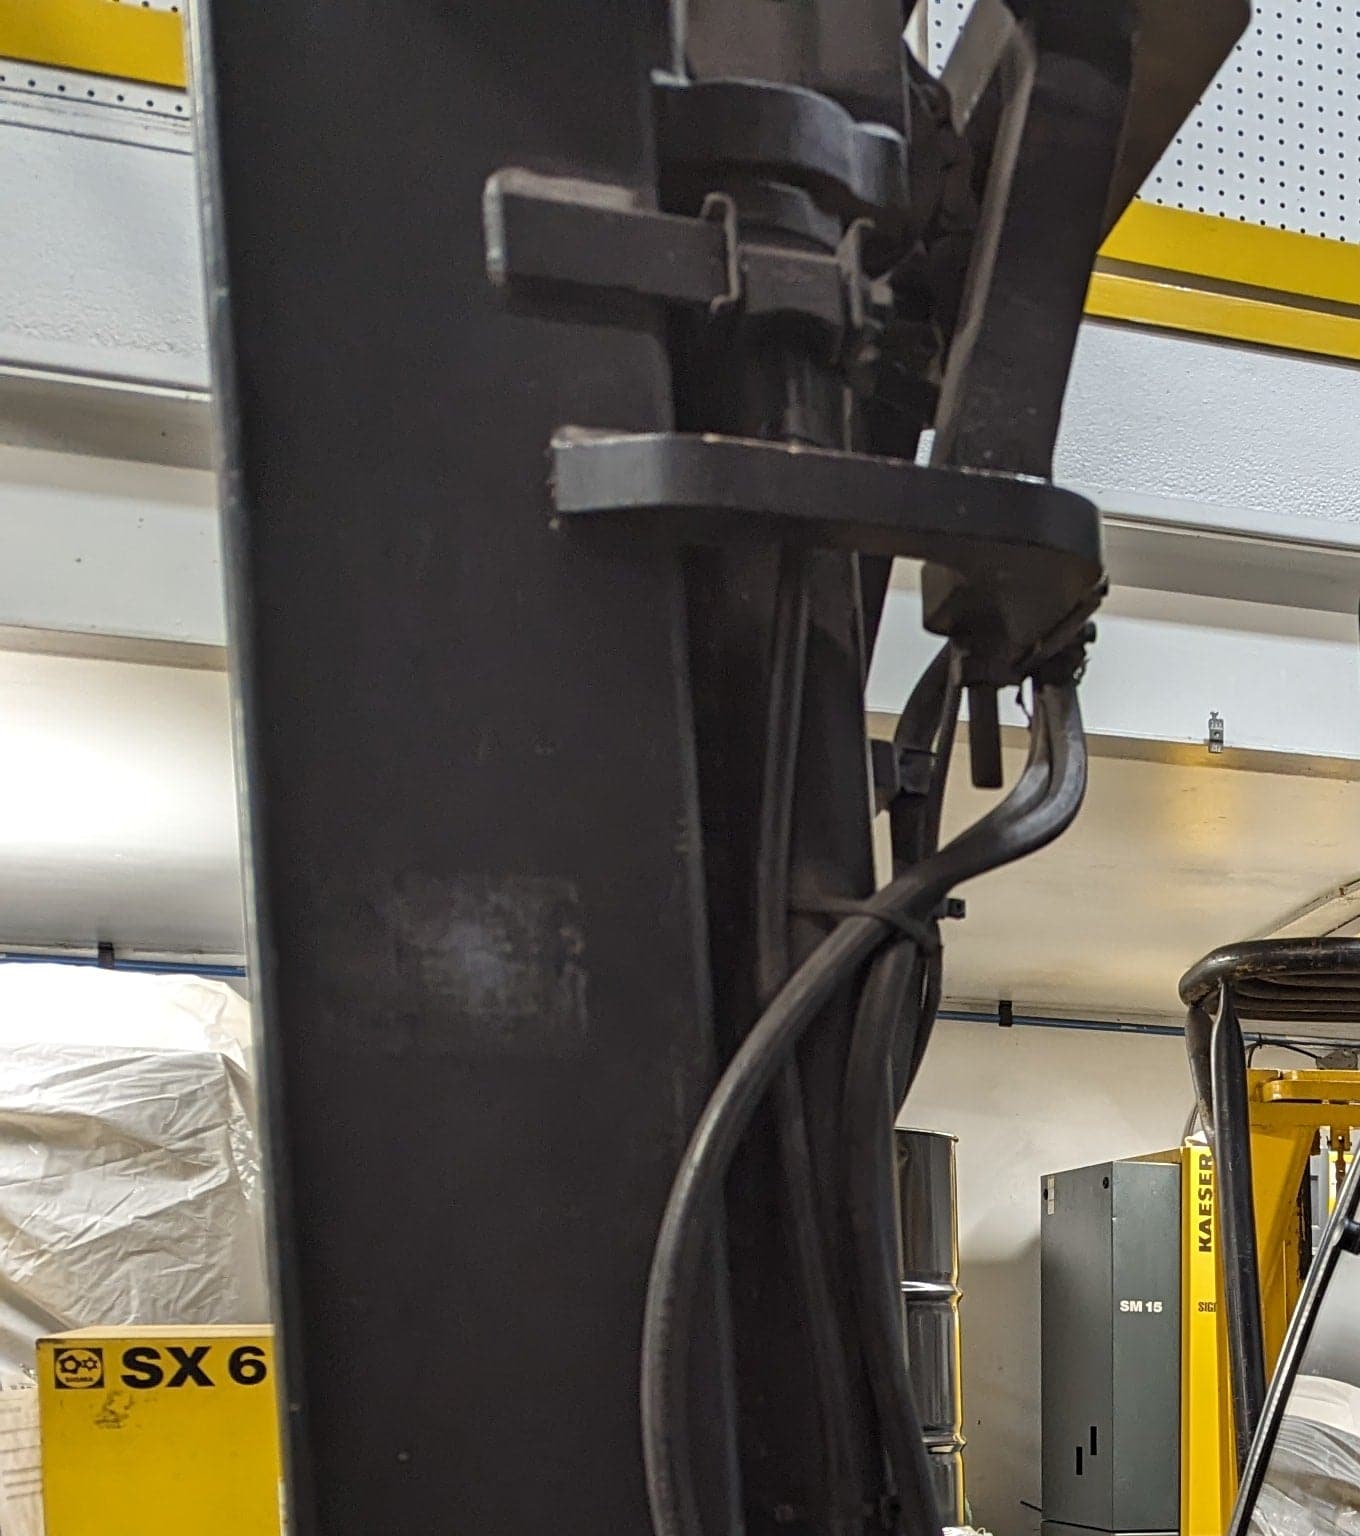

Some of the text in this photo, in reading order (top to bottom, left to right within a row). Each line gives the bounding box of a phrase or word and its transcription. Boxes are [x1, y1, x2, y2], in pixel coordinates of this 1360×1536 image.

[1197, 1153, 1214, 1253] KAESER
[1119, 1300, 1163, 1313] SM 15
[120, 1345, 268, 1390] SX 6
